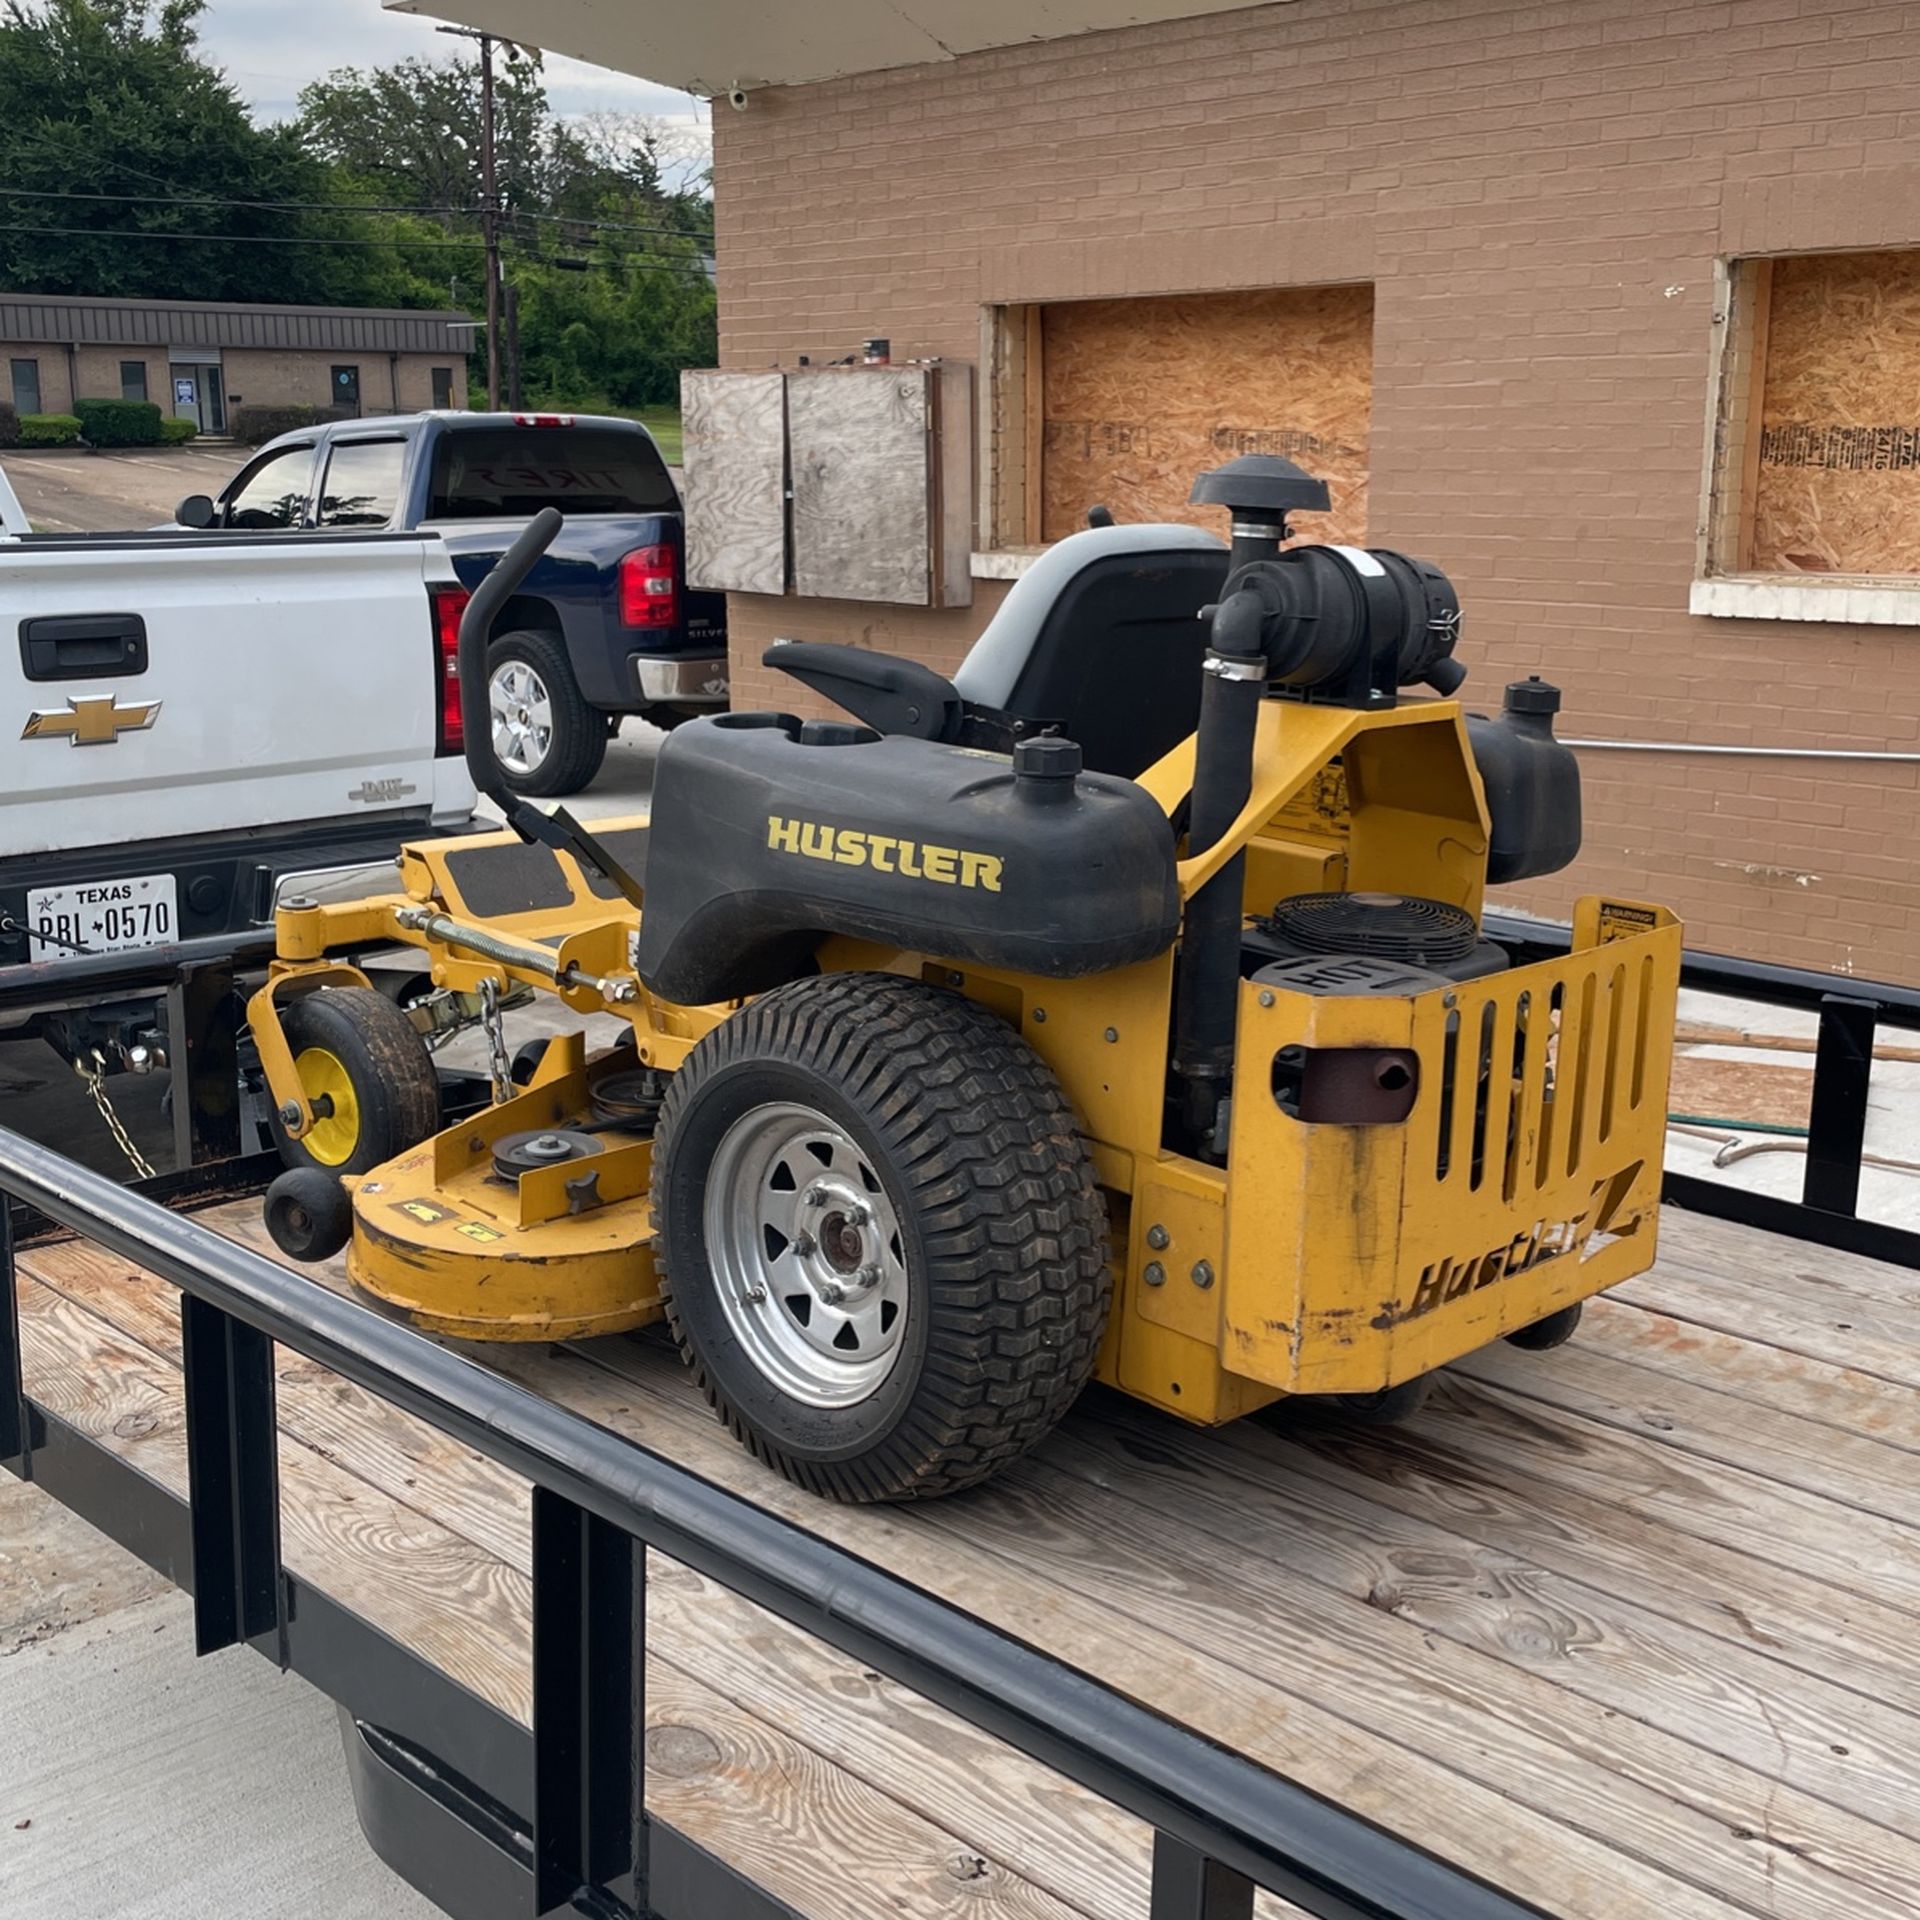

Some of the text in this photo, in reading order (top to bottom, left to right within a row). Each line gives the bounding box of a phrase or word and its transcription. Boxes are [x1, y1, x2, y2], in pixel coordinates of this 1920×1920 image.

[767, 815, 1003, 892] HUSTLER
[76, 885, 132, 905] TEXAS
[105, 902, 169, 940] 0570
[1282, 959, 1395, 989] HOT
[1411, 1210, 1589, 1310] Hustler
